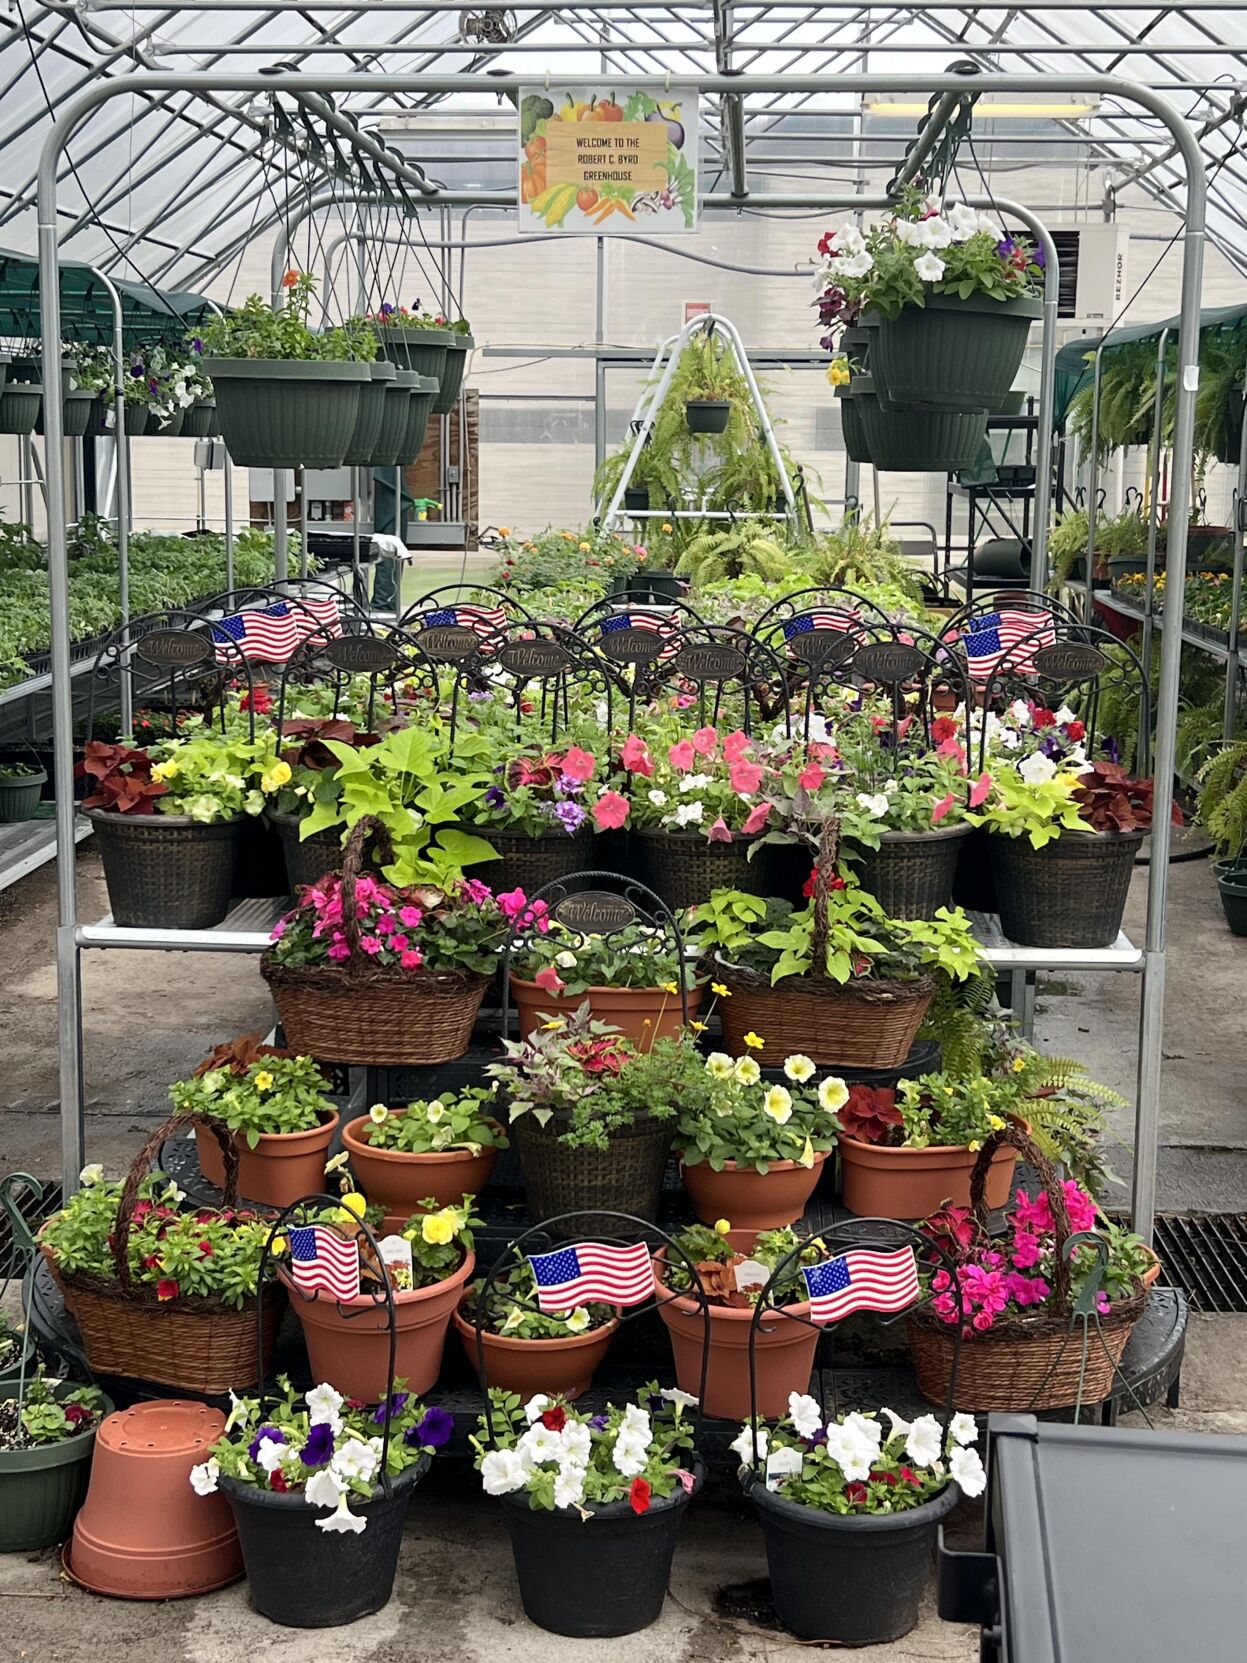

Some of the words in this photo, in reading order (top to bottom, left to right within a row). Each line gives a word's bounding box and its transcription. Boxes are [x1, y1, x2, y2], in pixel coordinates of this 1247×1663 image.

[576, 138, 612, 148] WELCOME
[614, 138, 624, 148] TO
[626, 138, 640, 148] THE
[577, 154, 606, 164] ROBERT
[608, 154, 616, 165] C.
[618, 154, 639, 164] BYRD
[583, 171, 632, 181] GREENHOUSE
[1115, 253, 1123, 301] REZNOR
[147, 638, 199, 656] Welcome
[508, 648, 560, 667] Welcome
[687, 652, 737, 672] Welcome
[864, 651, 914, 669] Welcome
[1044, 652, 1096, 671] Welcome
[567, 902, 624, 921] Welcome
